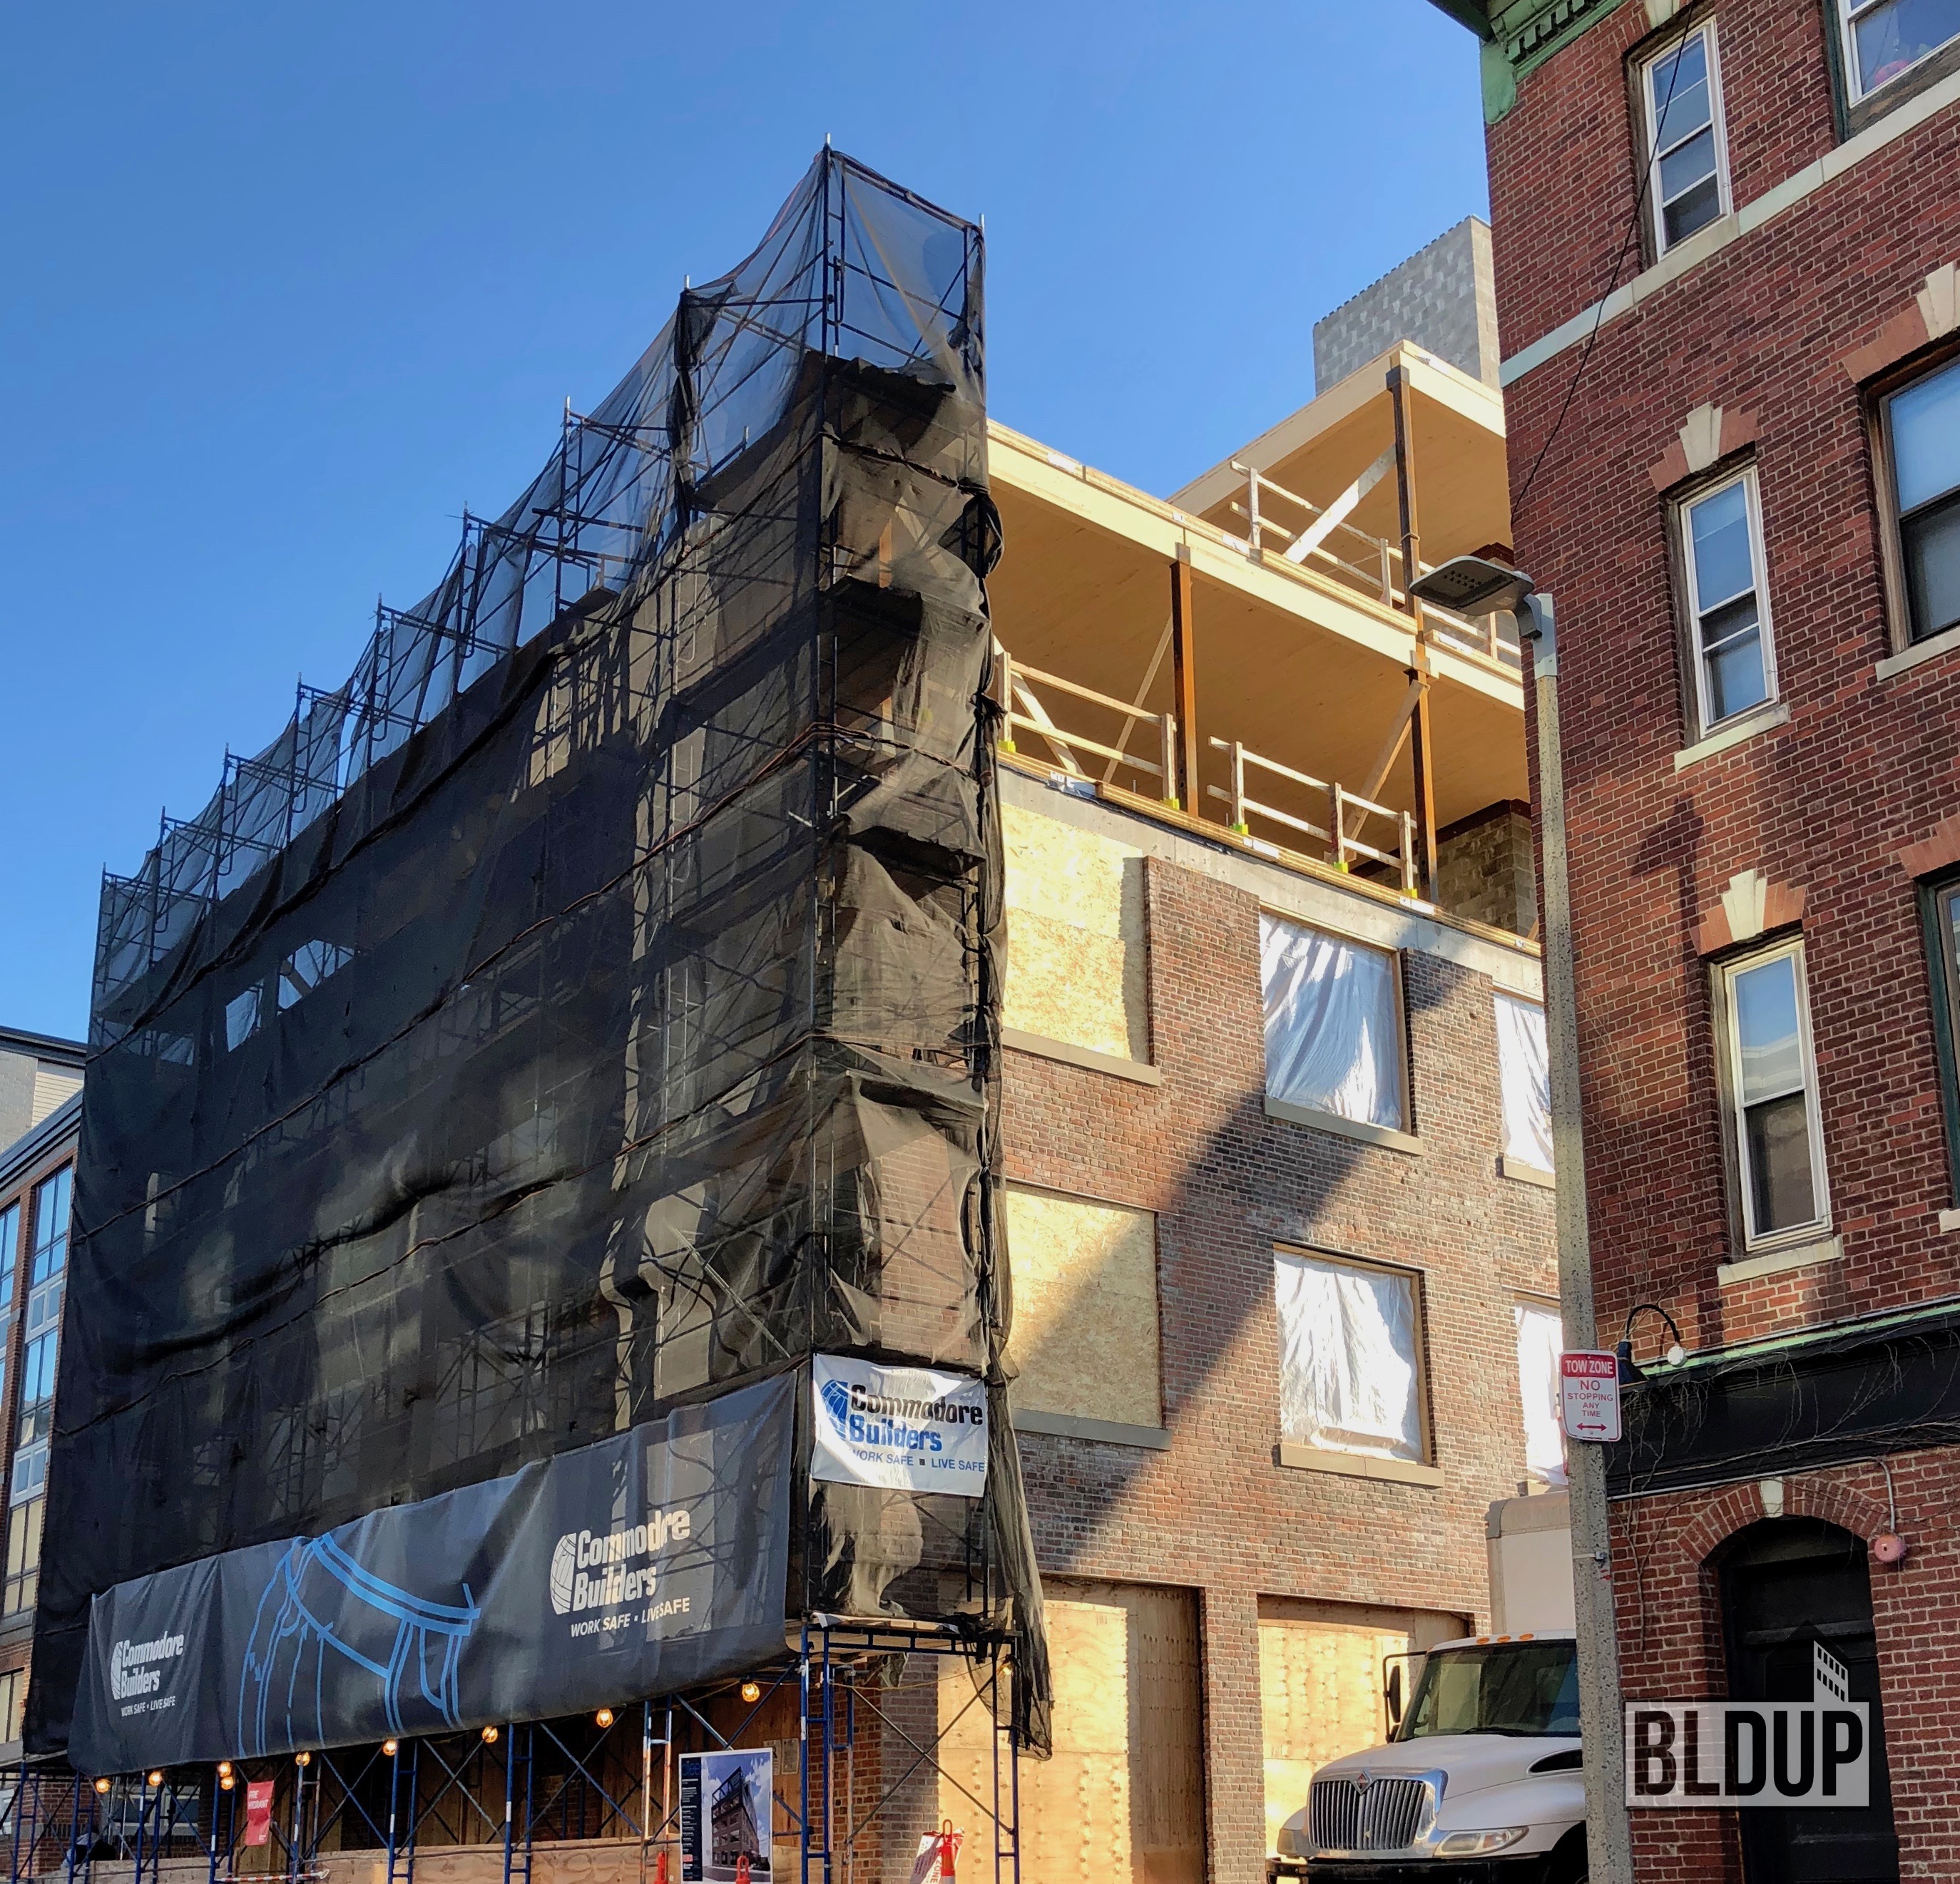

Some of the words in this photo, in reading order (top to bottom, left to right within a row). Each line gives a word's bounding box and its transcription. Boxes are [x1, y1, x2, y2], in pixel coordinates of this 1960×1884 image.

[1565, 1360, 1587, 1373] TOW
[1589, 1360, 1613, 1375] ZONE
[1567, 1392, 1613, 1401] STOPPING
[1580, 1379, 1601, 1391] NO
[851, 1384, 983, 1425] Commodore
[849, 1414, 942, 1452] Builders
[886, 1453, 914, 1466] SAFE
[931, 1458, 956, 1470] LIVE
[958, 1460, 985, 1472] SAFE
[573, 1564, 657, 1612] Builders
[571, 1618, 602, 1637] WORK
[602, 1613, 631, 1632] SAFE
[641, 1604, 660, 1624] LIVE
[659, 1597, 690, 1617] SAFE
[122, 1630, 185, 1668] Commodore
[121, 1666, 160, 1699] Builders
[133, 1702, 146, 1714] SAFE
[150, 1699, 163, 1711] LIVE
[163, 1695, 176, 1709] SAFE
